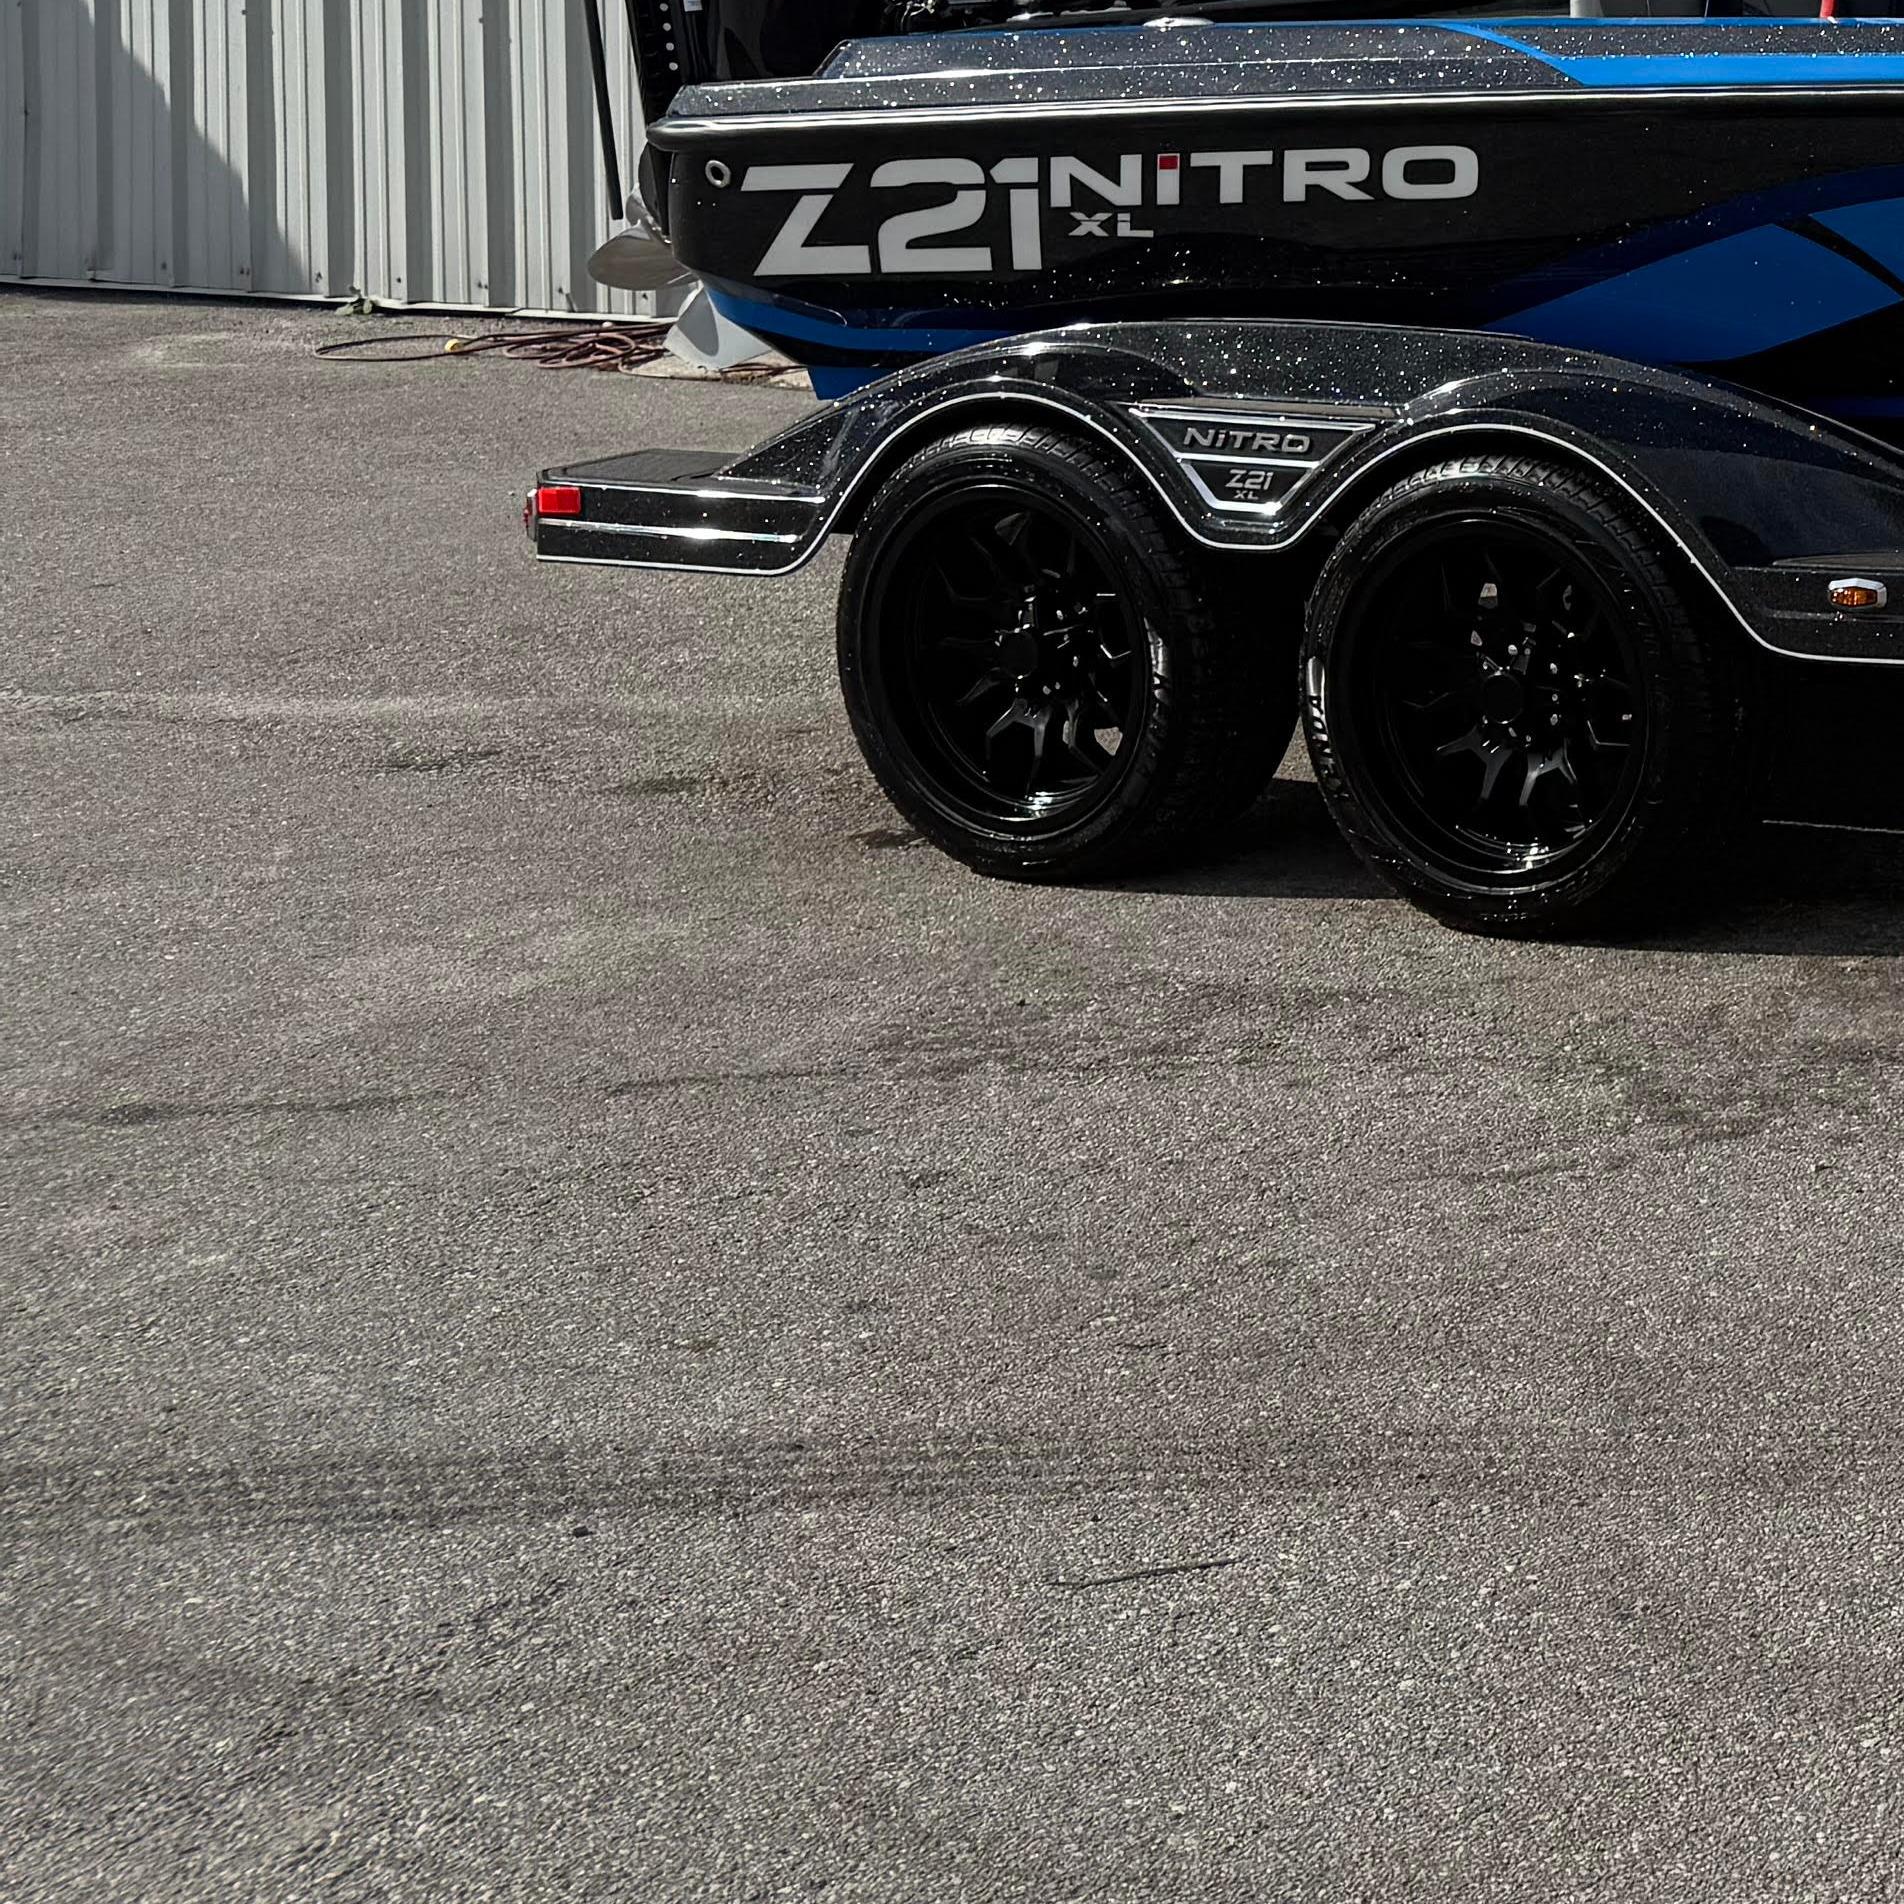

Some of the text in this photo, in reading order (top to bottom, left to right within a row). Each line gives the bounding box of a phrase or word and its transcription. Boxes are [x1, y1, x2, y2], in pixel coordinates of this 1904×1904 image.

[740, 157, 1043, 276] Z21
[1067, 211, 1155, 238] XL
[1224, 468, 1274, 491] Z21
[1233, 489, 1259, 501] XL
